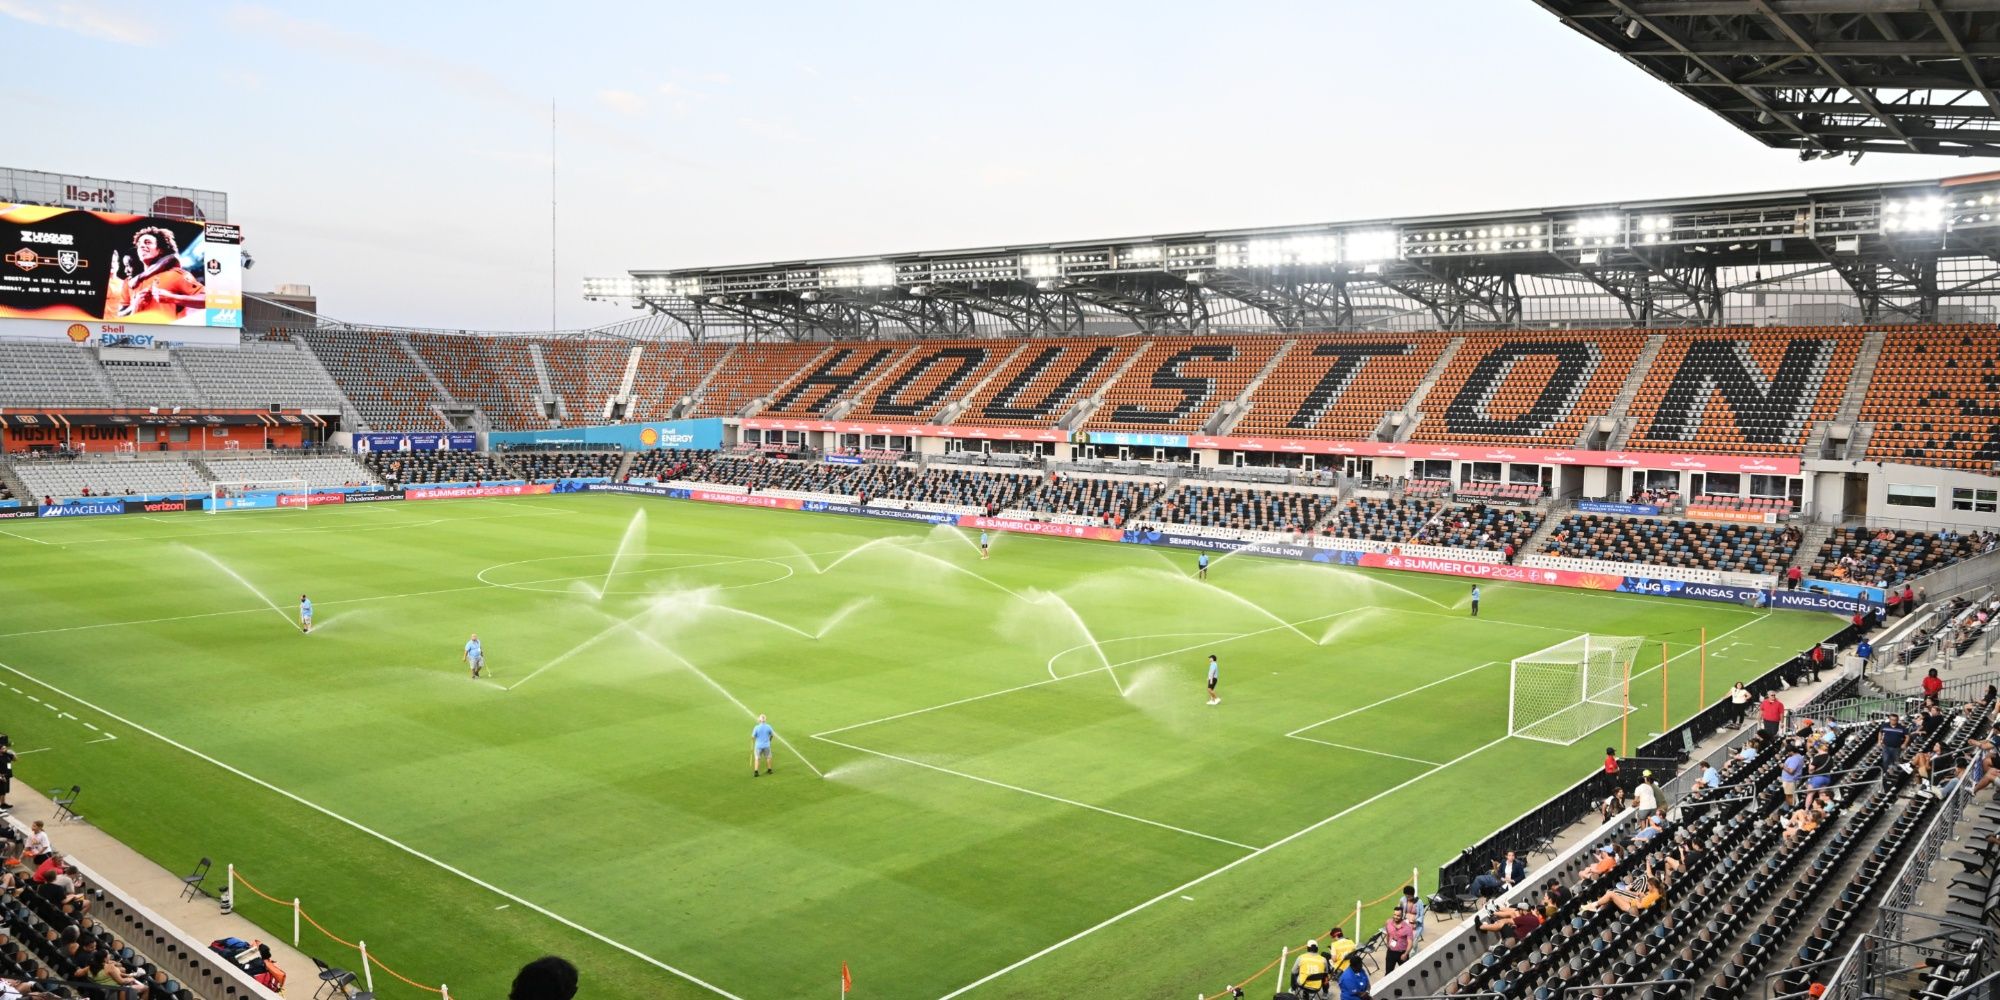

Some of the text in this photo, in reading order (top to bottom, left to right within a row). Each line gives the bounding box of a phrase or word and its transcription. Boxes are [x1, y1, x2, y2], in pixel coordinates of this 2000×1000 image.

[102, 325, 125, 334] Shell
[769, 337, 1838, 444] HOUSTON
[662, 434, 694, 443] ENERGY
[428, 488, 466, 497] SUMMER
[466, 488, 484, 496] CUP
[63, 504, 121, 515] MAGELLAN
[144, 502, 184, 512] verizon
[828, 505, 848, 513] KANSAS
[986, 519, 1063, 534] SUMMER CUP 2024
[1169, 537, 1303, 557] SEMIFINALS TICKETS ON SALE NOW
[1404, 558, 1525, 580] SUMMER CUP 2024
[1635, 581, 1767, 600] AUG 6 KANSAS CIT
[1916, 946, 1934, 957] 139
